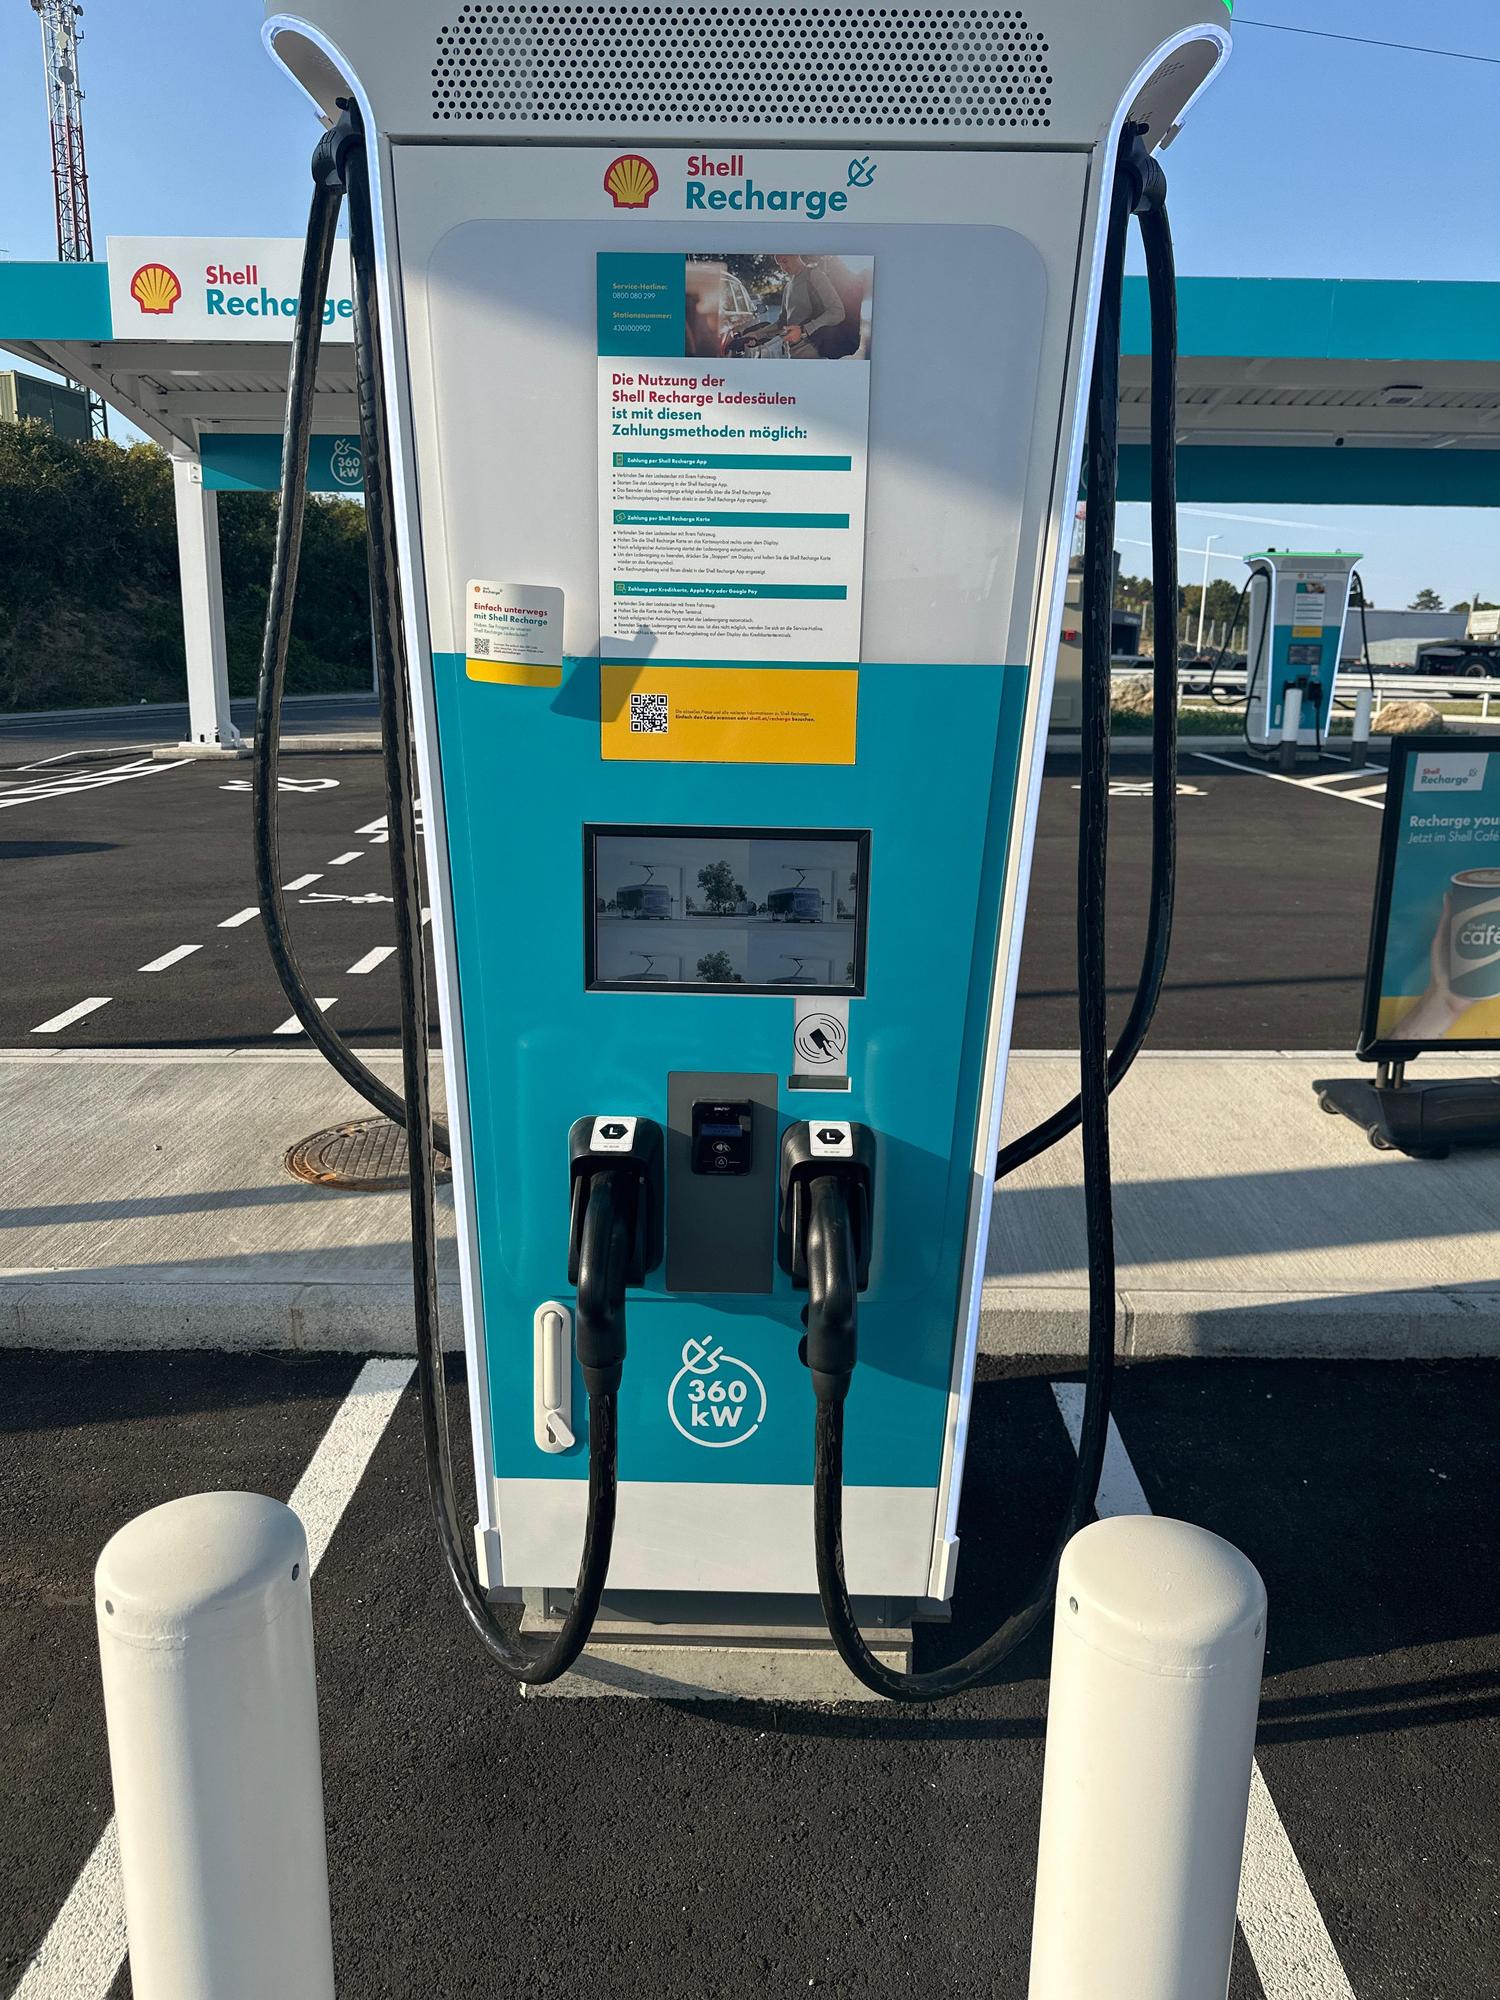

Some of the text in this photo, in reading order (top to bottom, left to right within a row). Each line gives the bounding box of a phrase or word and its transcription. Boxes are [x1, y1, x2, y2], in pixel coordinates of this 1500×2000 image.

[687, 155, 743, 176] Shell
[686, 180, 847, 220] Recharge
[206, 265, 258, 284] Shell
[206, 288, 353, 325] Rechage
[612, 374, 725, 389] Die Nutzung der
[612, 390, 796, 406] Shell Recharge Ladesäulen
[612, 407, 701, 420] ist mit diesen
[612, 424, 807, 441] Zahlungsmethoden möglich:
[338, 457, 360, 467] 360
[340, 467, 359, 477] kW
[474, 602, 548, 617] Einfach unterwegs
[489, 614, 508, 622] Shell
[510, 616, 548, 627] Recharge
[1421, 775, 1469, 786] Recharge
[1410, 814, 1500, 829] Recharge you
[1408, 832, 1432, 844] Jetzt
[1434, 832, 1446, 841] im
[1449, 830, 1472, 841] Shell
[688, 1380, 747, 1402] 360
[691, 1403, 743, 1427] kW
